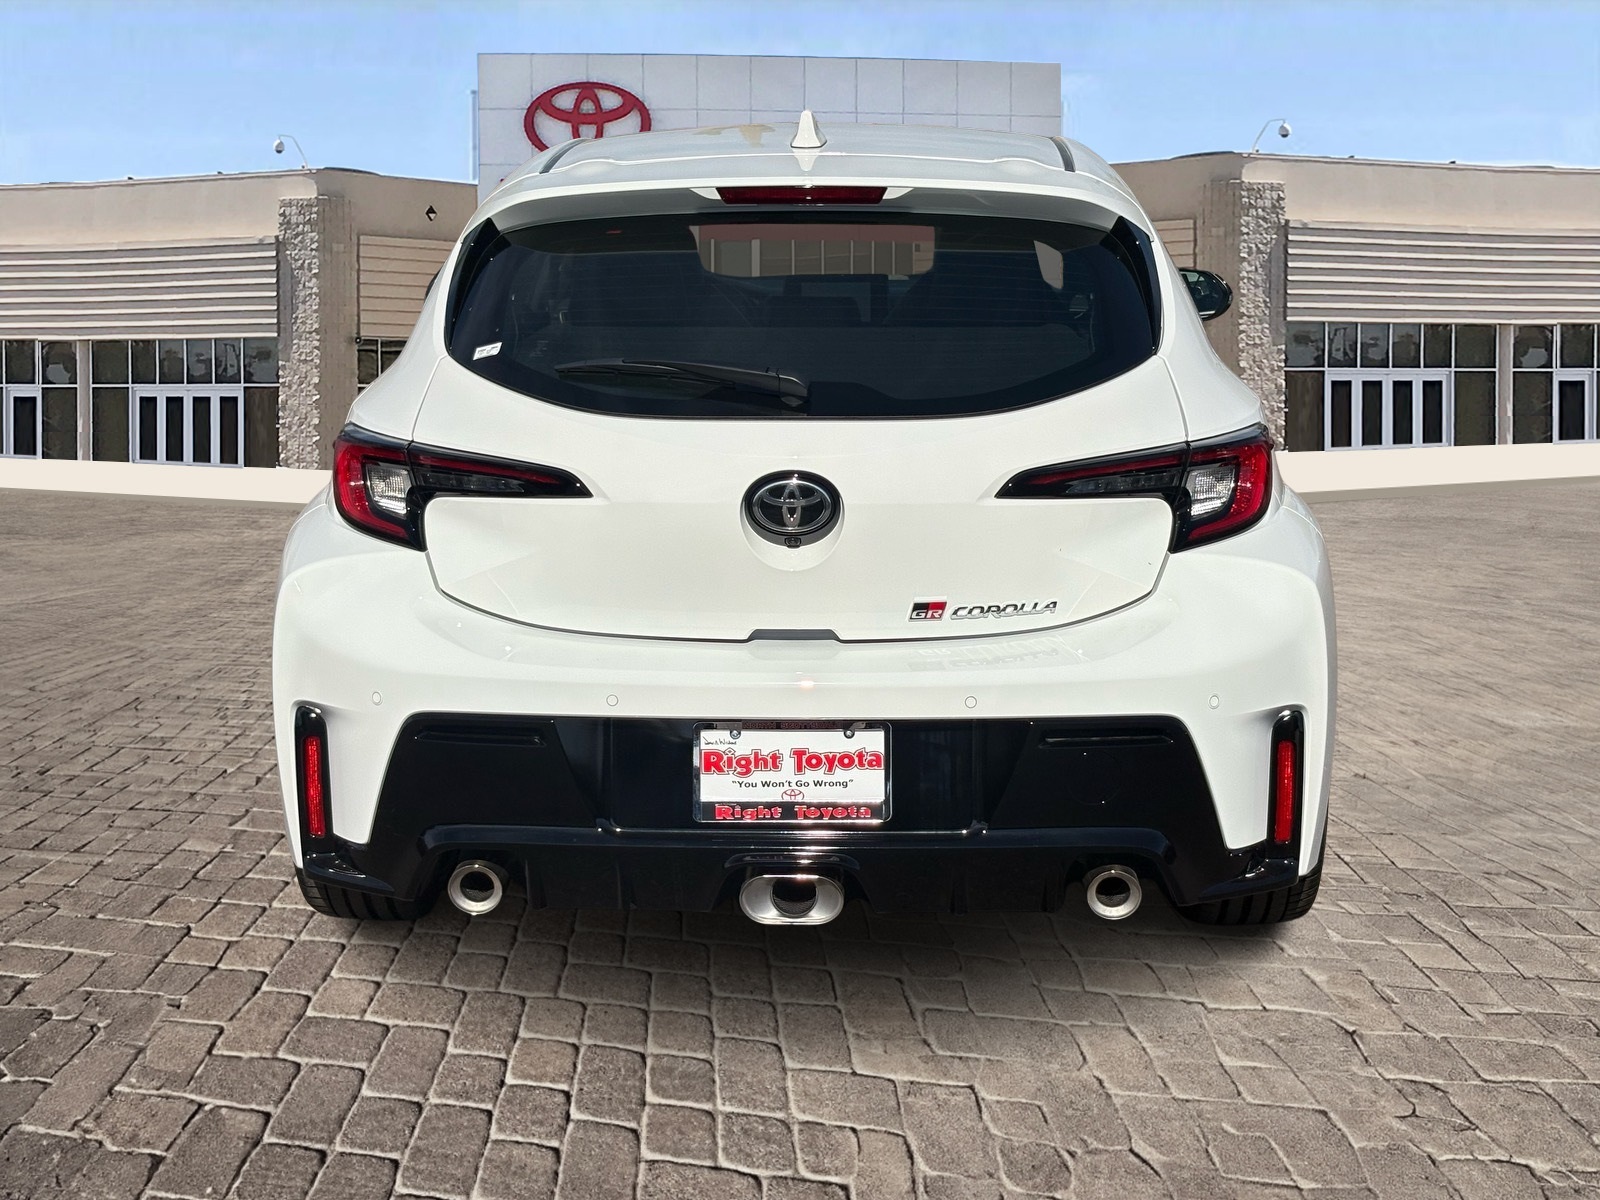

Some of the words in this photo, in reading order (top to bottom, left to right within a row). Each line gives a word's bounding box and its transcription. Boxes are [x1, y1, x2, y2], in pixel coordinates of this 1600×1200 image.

[951, 601, 1058, 620] COROLLA
[701, 747, 783, 778] Right
[790, 747, 884, 775] Toyota
[761, 780, 792, 788] Won't
[795, 780, 810, 788] Go
[715, 805, 782, 821] Right
[794, 805, 871, 820] Toyota
